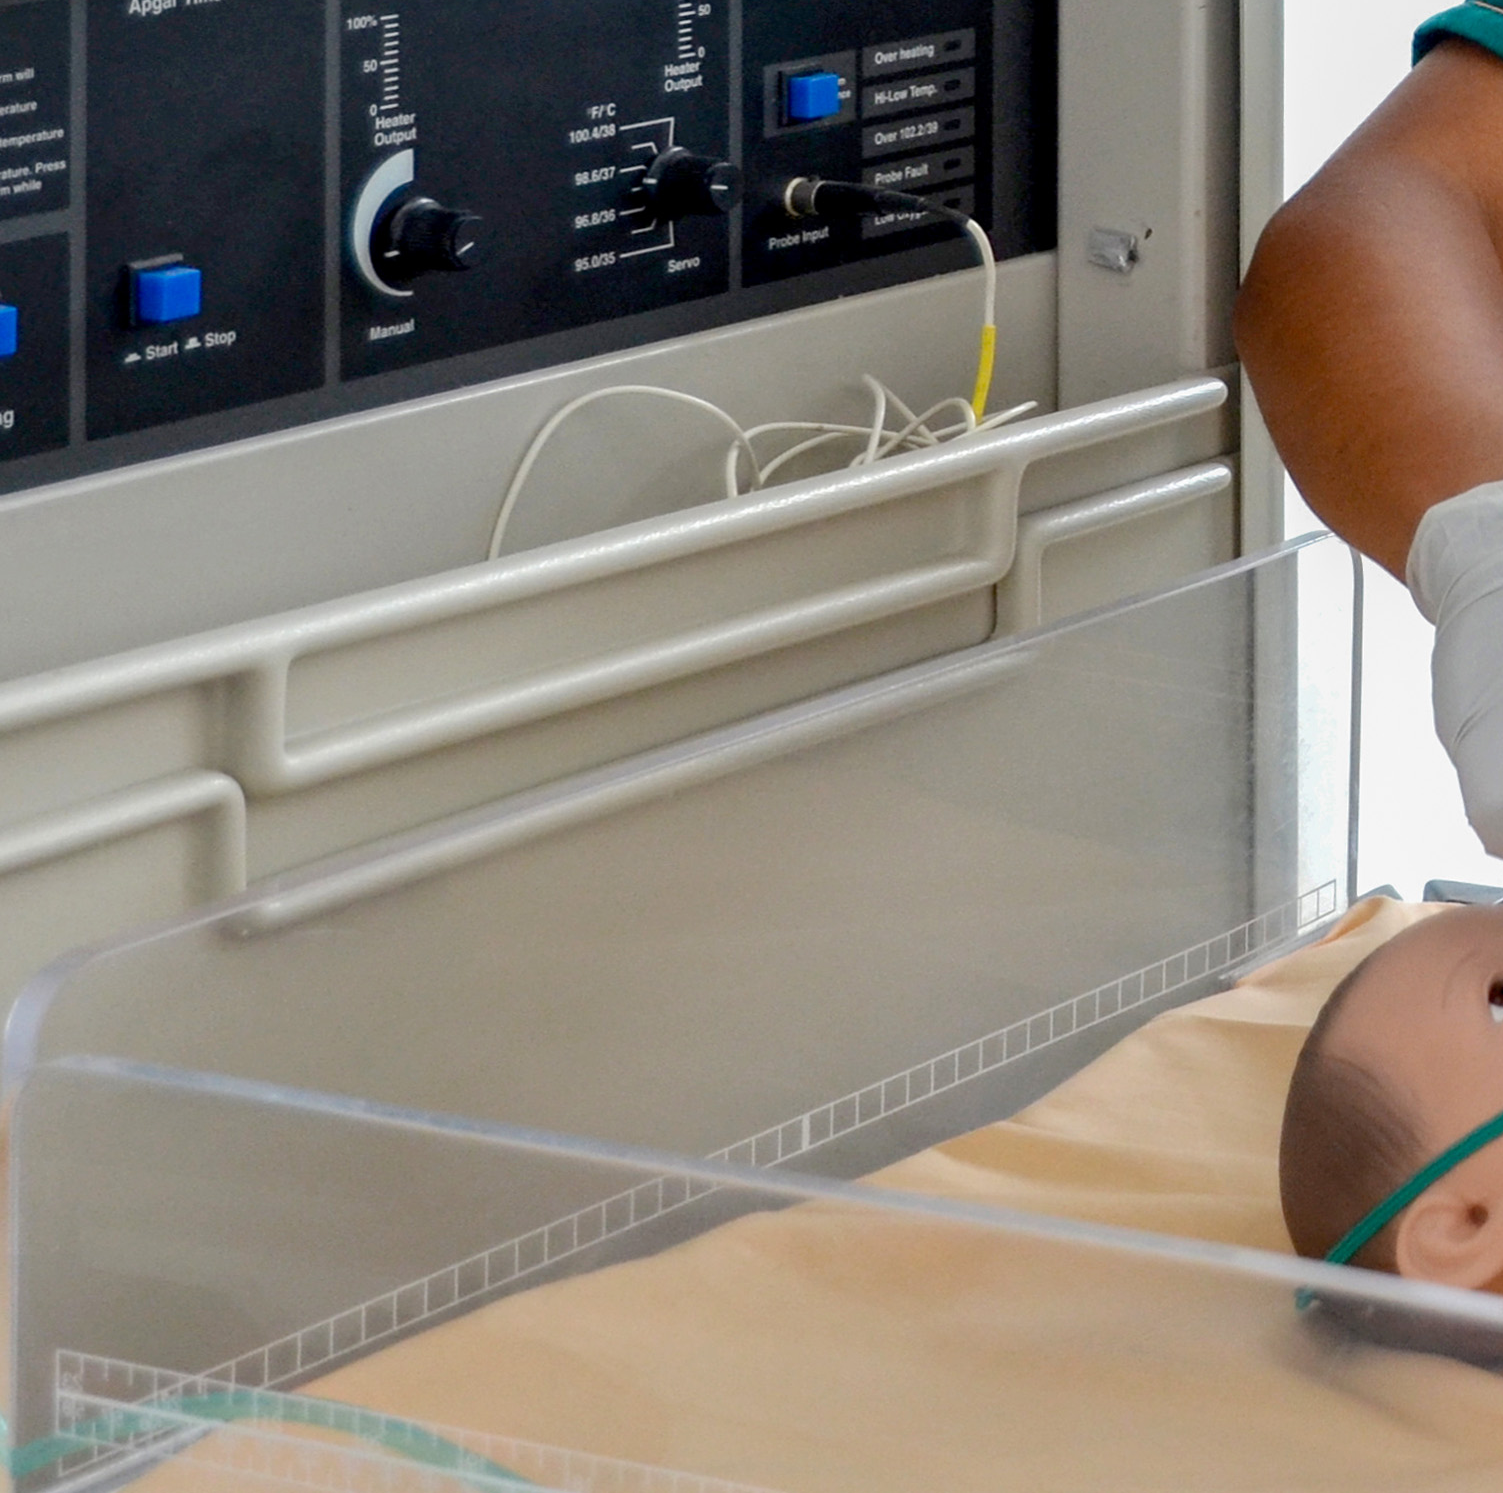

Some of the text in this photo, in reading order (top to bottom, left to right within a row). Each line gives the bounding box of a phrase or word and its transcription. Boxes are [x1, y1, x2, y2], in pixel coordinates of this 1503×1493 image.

[698, 3, 711, 17] 50
[346, 15, 378, 30] 100%
[698, 46, 706, 58] 0
[874, 44, 936, 65] Over heating
[363, 59, 378, 74] 50
[664, 61, 701, 78] Heater
[664, 74, 703, 92] Output
[369, 103, 378, 117] 0
[375, 113, 416, 130] Heater
[374, 127, 417, 146] Output
[874, 131, 898, 146] Over
[35, 160, 67, 174] Press
[874, 163, 929, 185] Probe Fault
[768, 225, 830, 250] Probe Input
[667, 256, 700, 273] Servo
[369, 320, 415, 341] Manual
[145, 329, 237, 361] Start Stop
